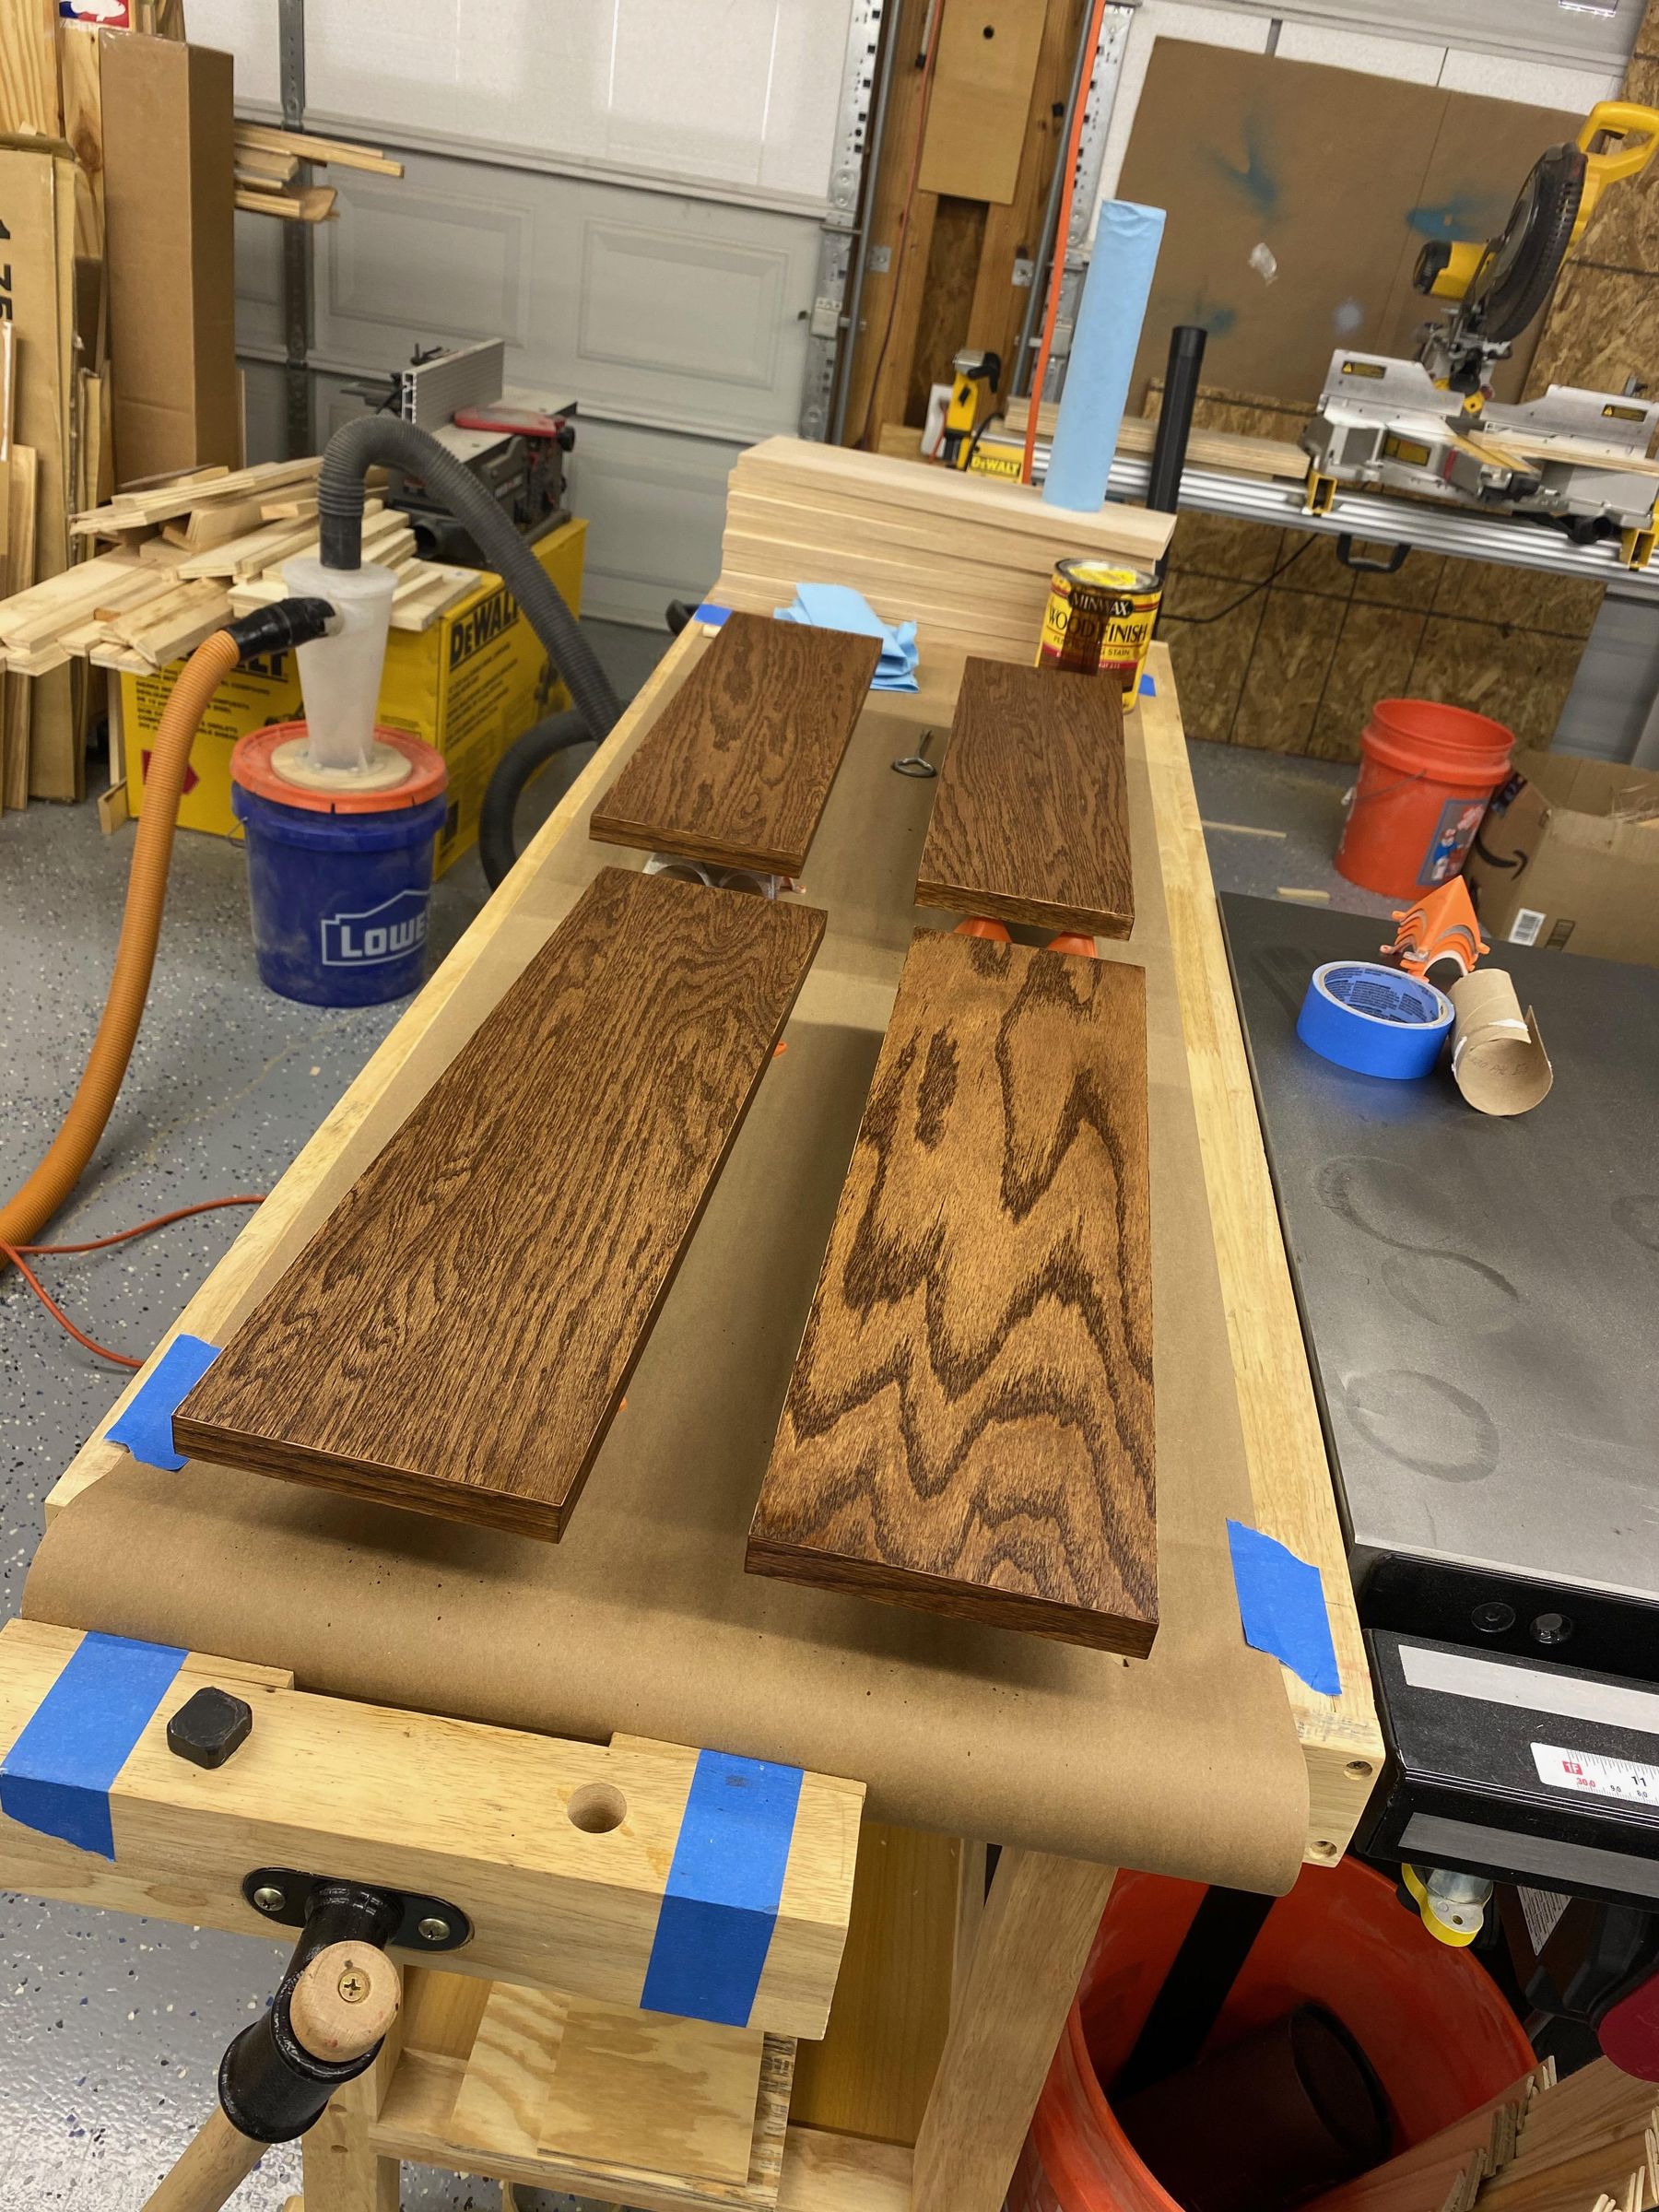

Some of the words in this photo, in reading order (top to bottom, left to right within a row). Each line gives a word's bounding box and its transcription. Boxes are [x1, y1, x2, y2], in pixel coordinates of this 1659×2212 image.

[1071, 592, 1130, 617] MINWAX
[1048, 605, 1096, 638] WOOD
[1108, 648, 1130, 656] STAIN
[1564, 1761, 1582, 1774] 1F
[1631, 1776, 1646, 1786] 11
